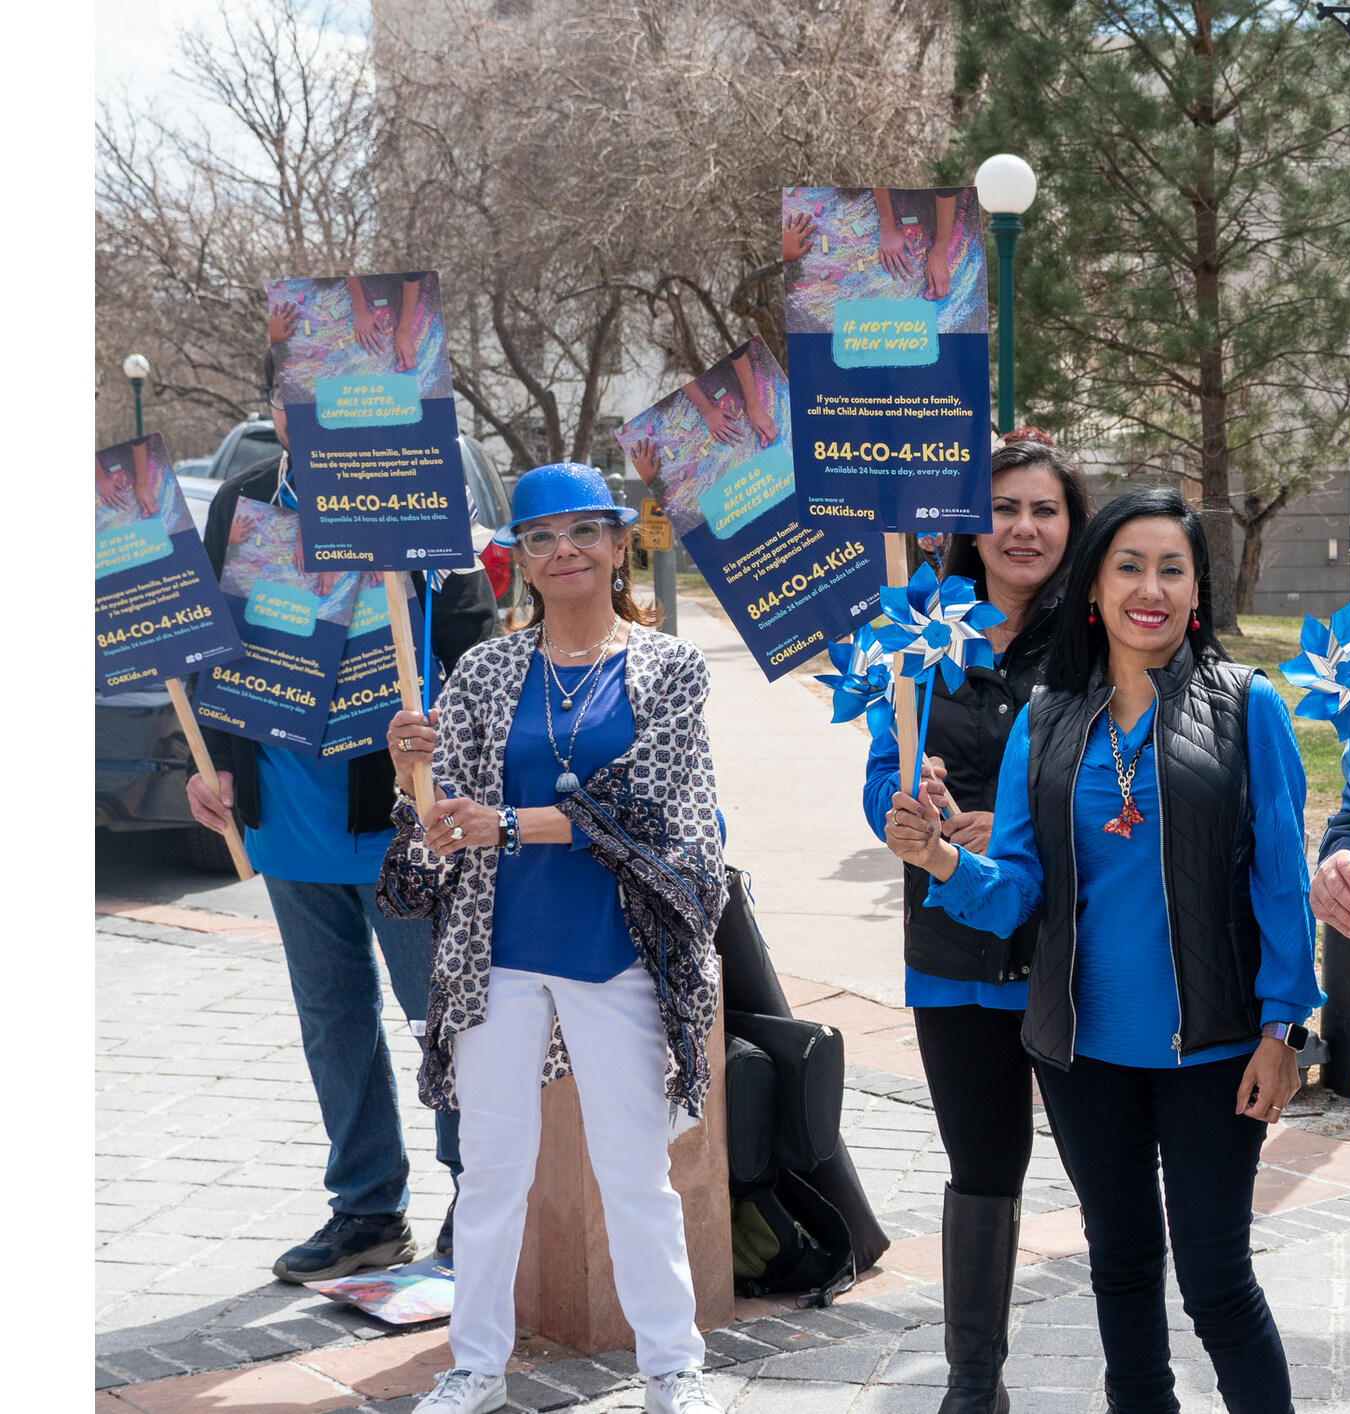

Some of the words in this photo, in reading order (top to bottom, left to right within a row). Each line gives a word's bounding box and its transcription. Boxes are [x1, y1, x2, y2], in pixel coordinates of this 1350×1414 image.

[843, 320, 857, 334] IF
[859, 321, 892, 333] NOT
[894, 321, 927, 335] YOU,
[843, 337, 882, 351] THEN
[885, 338, 928, 351] WHO?
[342, 386, 351, 395] SI
[353, 386, 368, 394] NO
[370, 385, 384, 393] LO
[336, 397, 359, 407] HACE
[362, 396, 393, 407] USTED,
[817, 394, 823, 403] If
[850, 395, 892, 404] concerned
[894, 396, 920, 404] about
[930, 395, 961, 406] family,
[807, 407, 821, 415] call
[823, 407, 835, 415] the
[837, 407, 857, 416] Child
[858, 407, 884, 416] Abuse
[885, 408, 902, 416] and
[904, 408, 938, 418] Neglect
[941, 407, 973, 416] Hotline
[319, 450, 326, 458] le
[326, 451, 359, 460] preocupa
[373, 449, 400, 457] familia,
[814, 441, 971, 462] 844-CO-4-Kids
[825, 466, 858, 474] Available
[869, 467, 890, 475] hours
[898, 467, 915, 477] day,
[917, 469, 940, 477] every
[942, 467, 960, 477] day.
[724, 485, 732, 498] SI
[734, 477, 747, 491] NO
[749, 468, 761, 480] LO
[724, 492, 745, 511] HACE
[746, 474, 775, 496] USTED,
[317, 491, 448, 512] 844-CO-4-Kids
[810, 505, 875, 520] CO4Kids.org
[316, 550, 375, 561] CO4Kids.org
[723, 565, 731, 574] Si
[736, 544, 765, 567] preocupa
[764, 536, 778, 547] una
[753, 573, 758, 581] y
[765, 545, 802, 572] negligencia
[800, 529, 825, 548] infantil
[747, 541, 865, 620] 844-CO-4-Kids
[97, 604, 212, 647] 844-CO-4-Kids
[771, 630, 824, 665] CO4Kids.org
[108, 668, 158, 686] CO4Kids.org
